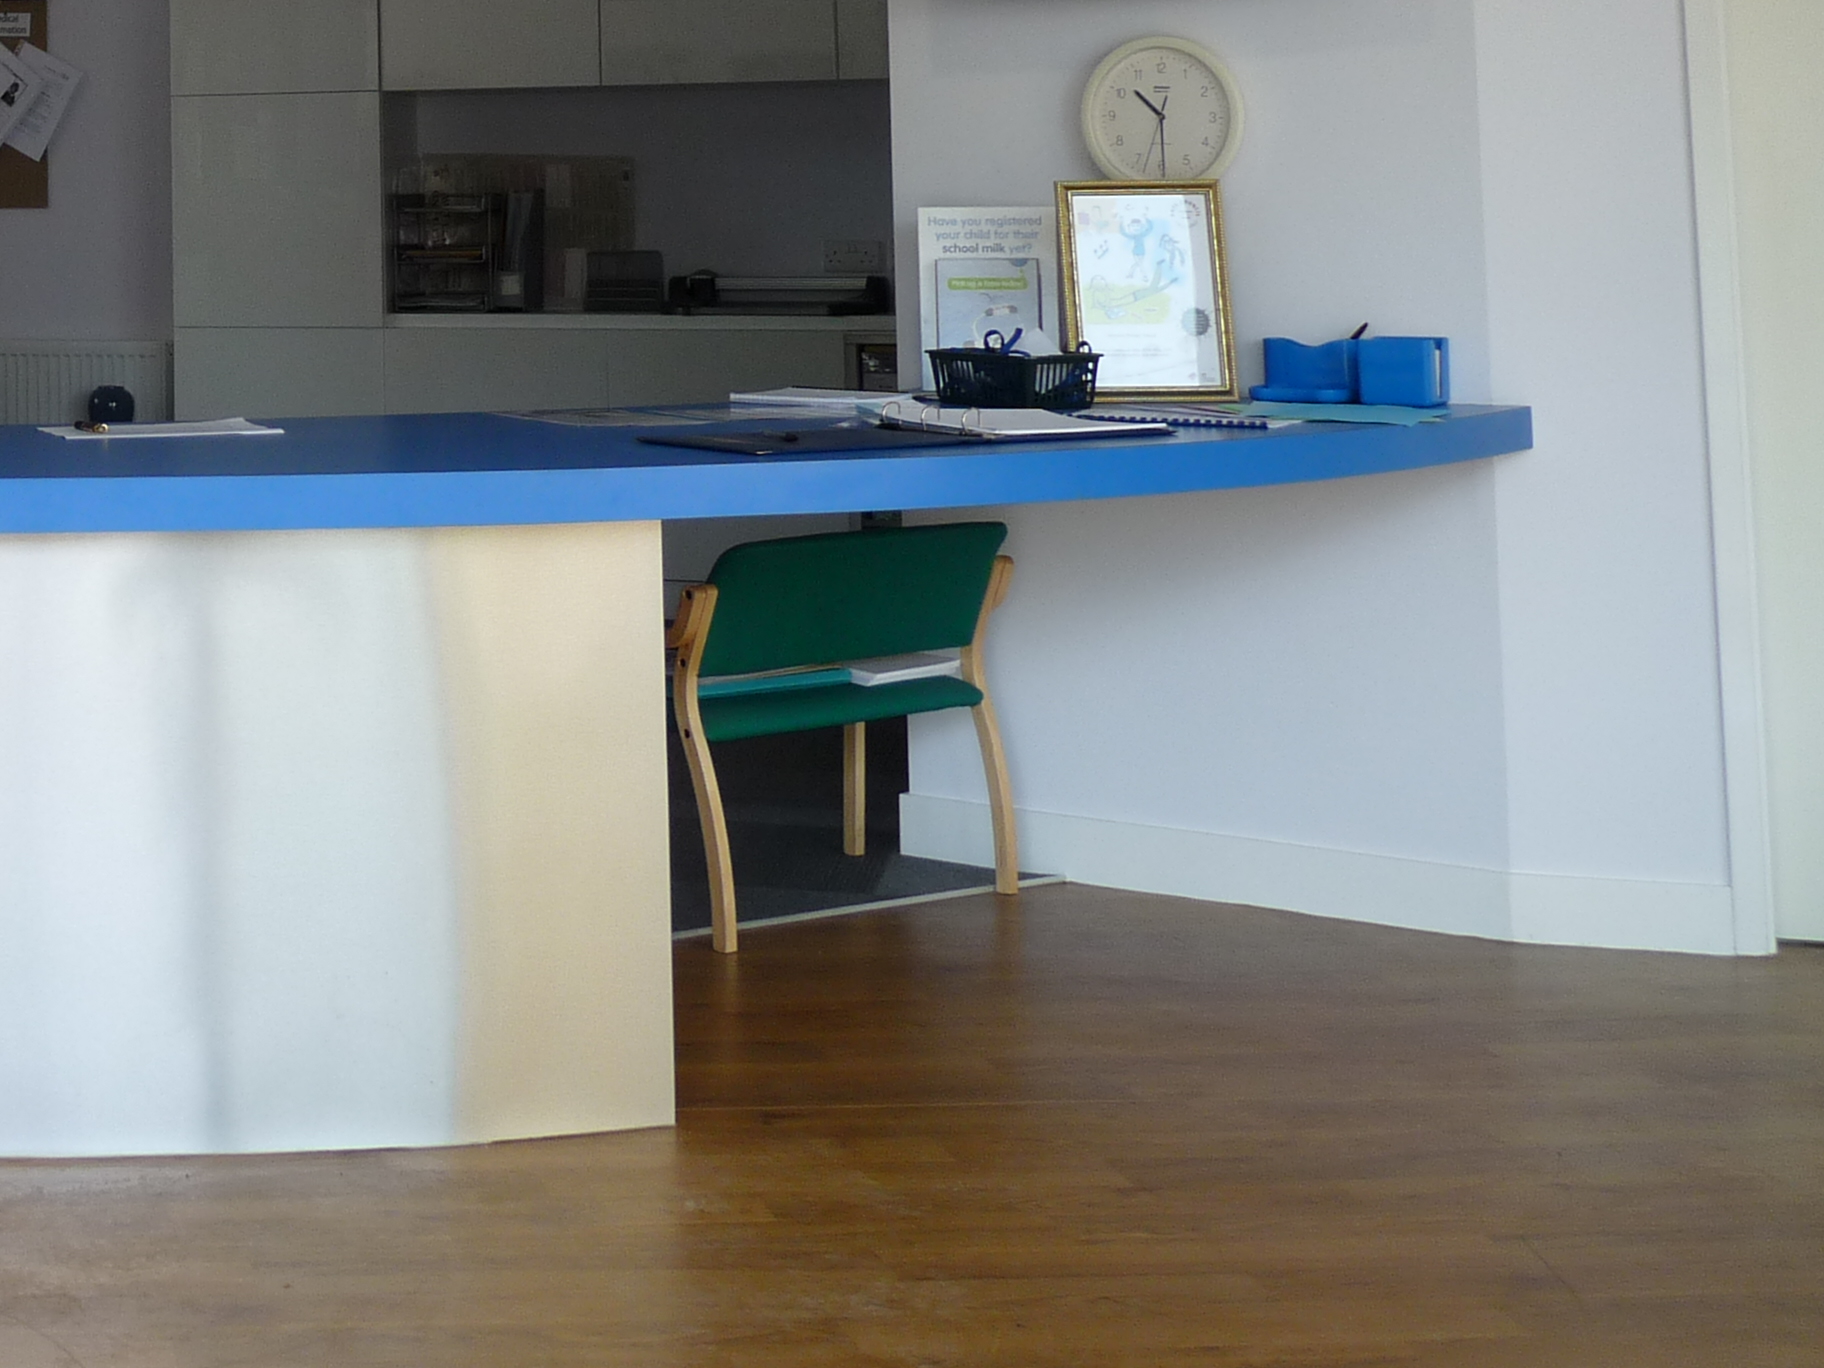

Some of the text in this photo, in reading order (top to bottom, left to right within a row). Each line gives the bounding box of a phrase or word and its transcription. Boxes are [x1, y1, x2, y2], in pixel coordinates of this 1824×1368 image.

[1155, 62, 1167, 74] 12
[1133, 69, 1143, 81] 11
[1116, 87, 1126, 99] 10
[1200, 86, 1209, 98] 2
[1108, 110, 1116, 121] 9
[1208, 112, 1217, 123] 3
[1116, 135, 1124, 146] 8
[1201, 136, 1209, 147] 4
[1135, 153, 1142, 165] 7
[1182, 154, 1191, 166] 5
[927, 215, 1042, 229] Have you registered
[935, 229, 1040, 241] your child for their
[942, 242, 1033, 255] school milk yet?
